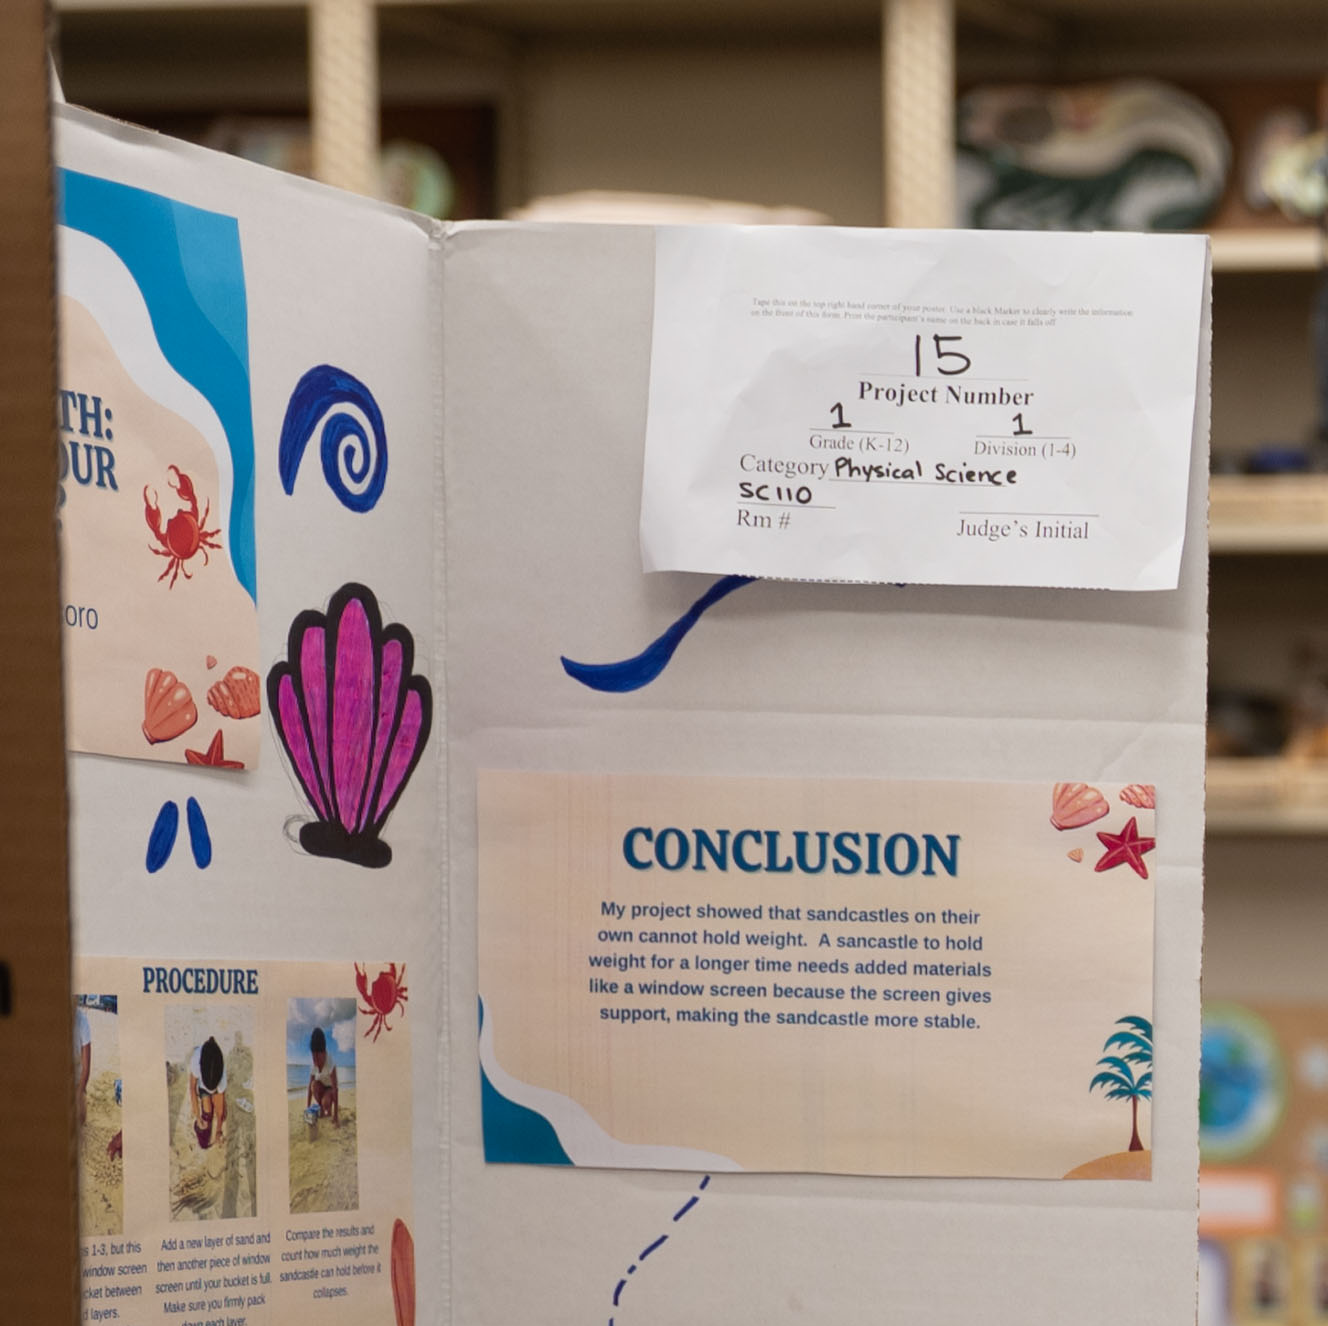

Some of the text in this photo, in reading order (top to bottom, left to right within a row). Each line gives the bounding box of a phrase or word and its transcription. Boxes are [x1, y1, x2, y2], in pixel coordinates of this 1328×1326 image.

[914, 335, 971, 376] 15
[858, 380, 1034, 406] Project Number
[830, 403, 852, 429] 1
[1012, 414, 1032, 436] 1
[810, 434, 910, 454] Grade (K-12)
[974, 440, 1077, 459] Division (1-4)
[740, 455, 829, 478] Category
[835, 456, 1017, 485] Physical Science
[737, 509, 791, 529] Rm #
[957, 519, 1089, 540] Judge's Initial
[64, 604, 99, 630] oro
[622, 826, 962, 878] CONCLUSION
[600, 901, 981, 925] My project showed that sandcastles on their
[598, 929, 983, 951] own cannot hold weight. A sancastle to hold
[588, 952, 992, 978] weight for a longer time needs added materials
[142, 967, 259, 995] PROCEDURE
[589, 977, 992, 1007] like a window screen because the screen gives
[599, 1007, 981, 1030] support, making the sandcastle more stable.
